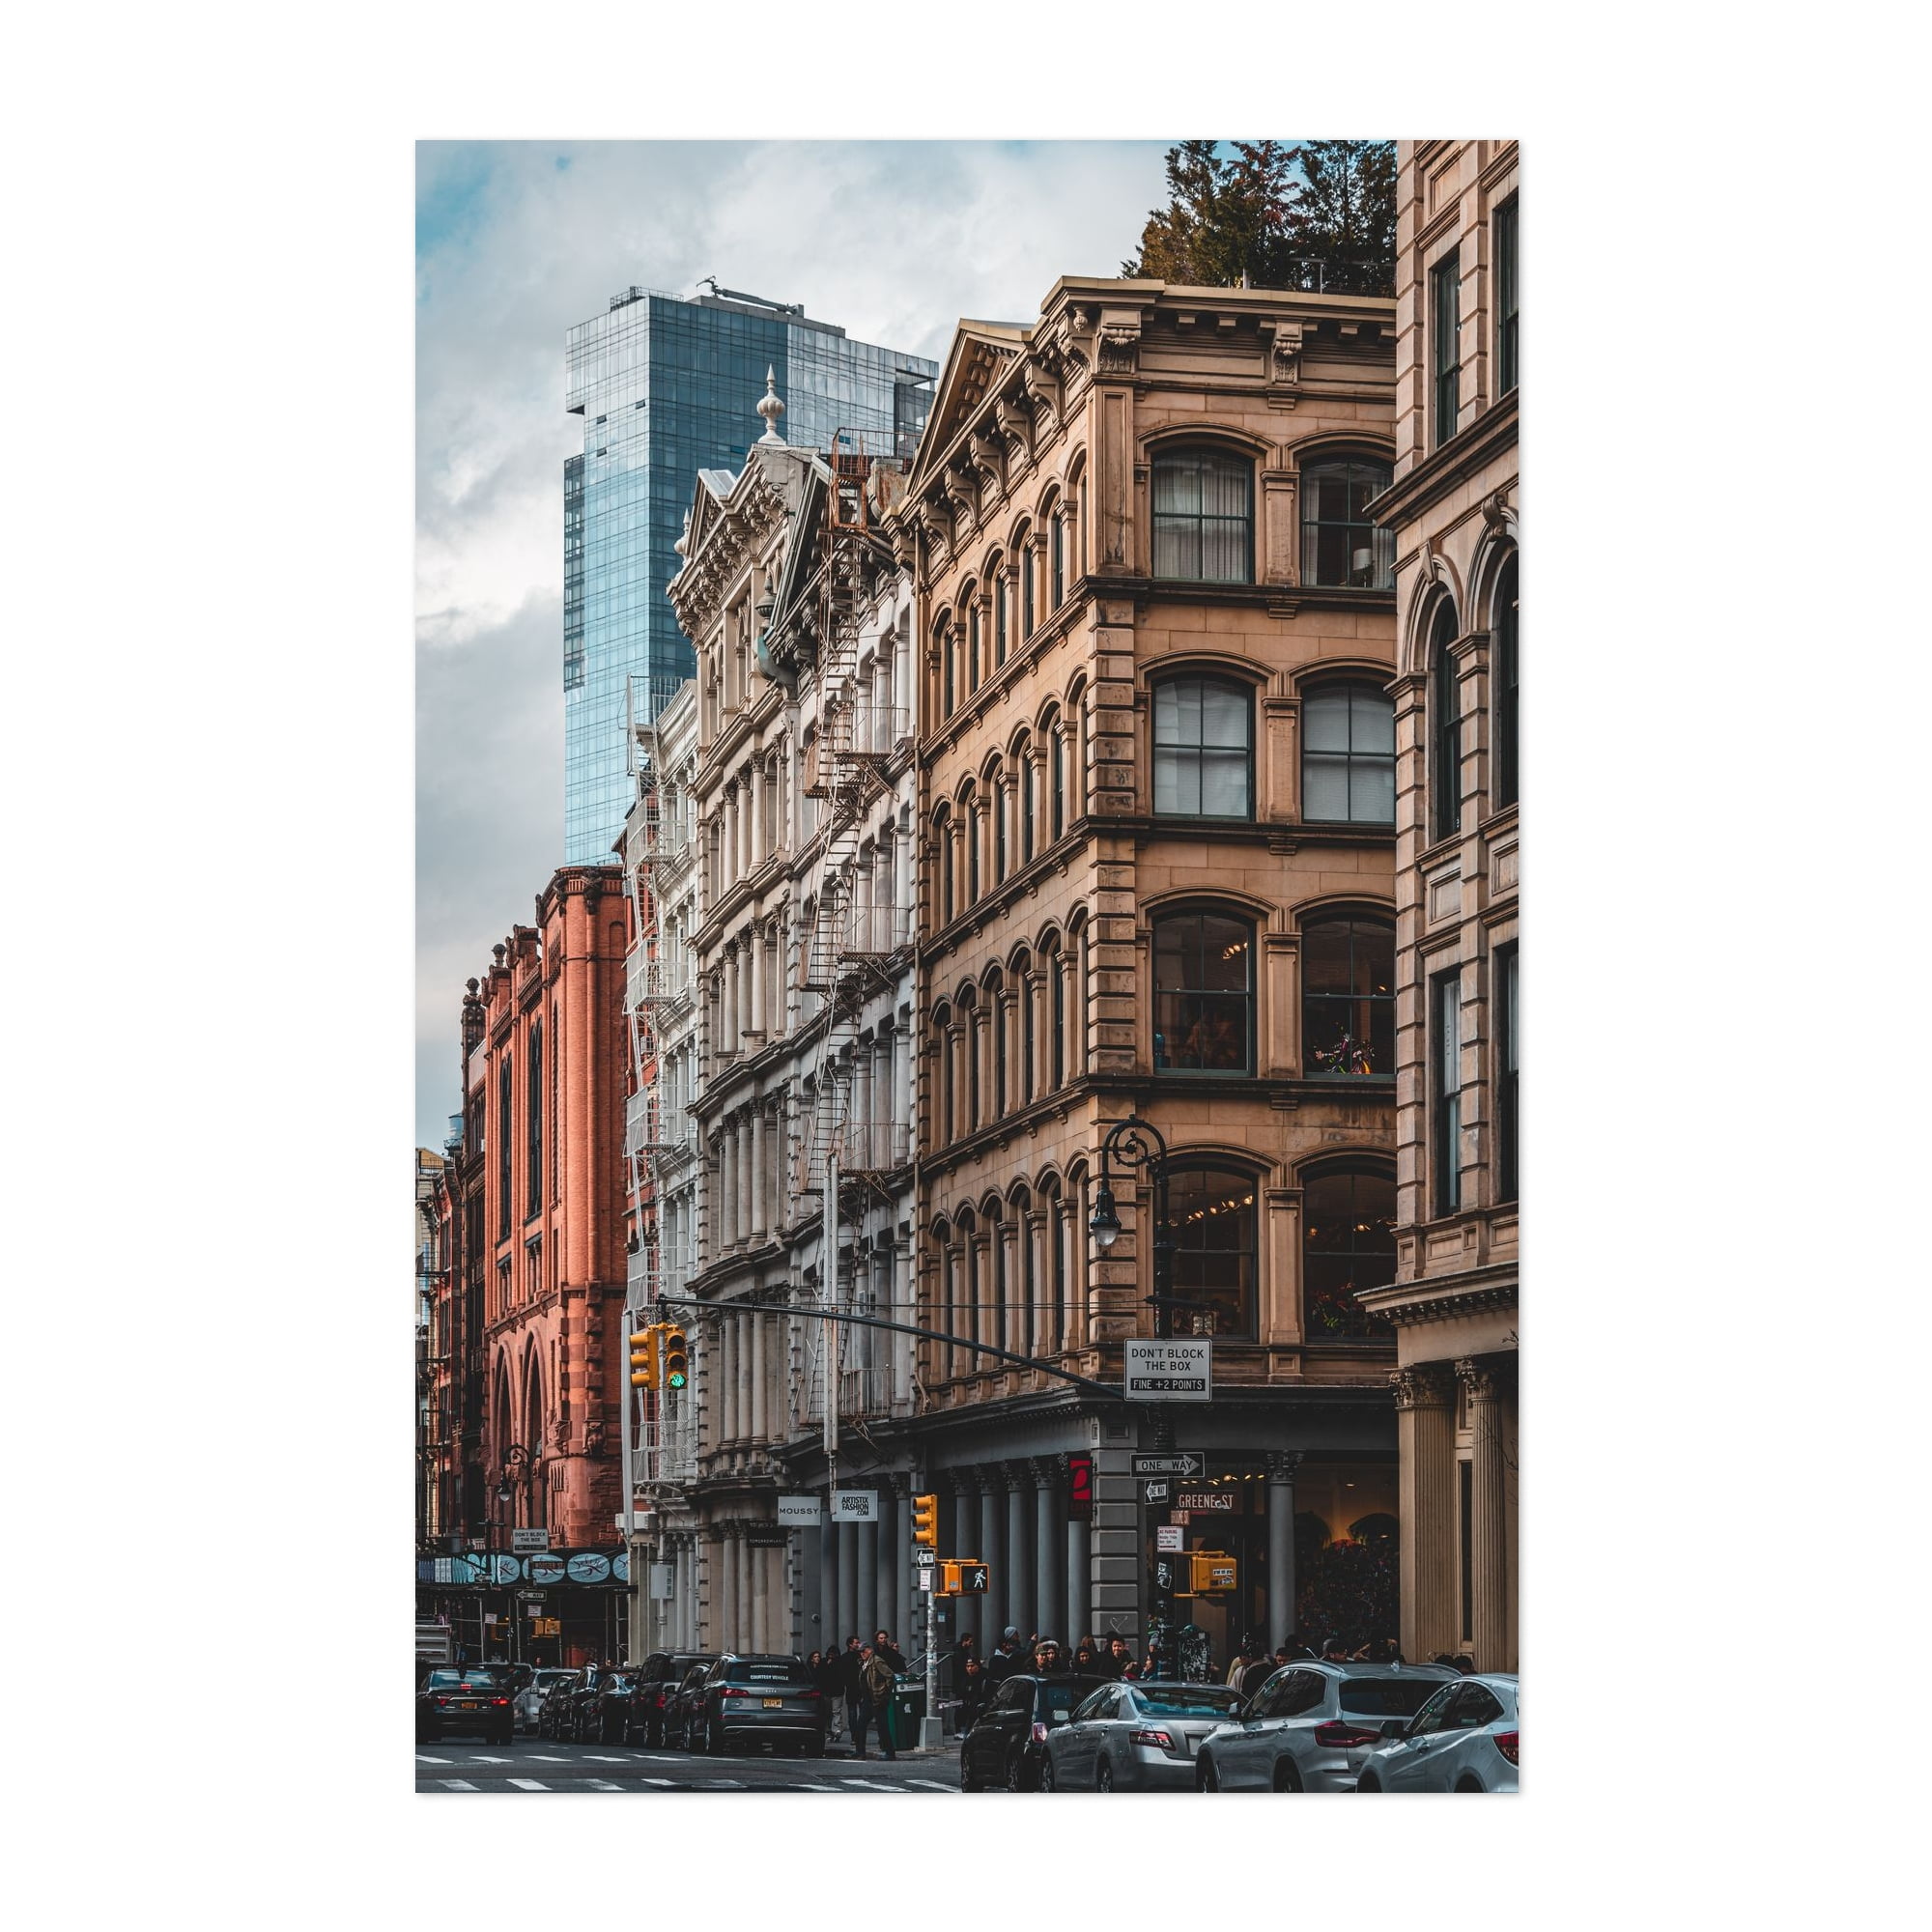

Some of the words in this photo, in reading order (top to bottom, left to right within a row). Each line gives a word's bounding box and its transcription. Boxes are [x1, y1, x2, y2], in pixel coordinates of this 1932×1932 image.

[1131, 1348, 1164, 1358] DON'T
[1167, 1349, 1205, 1359] BLOCK
[1145, 1360, 1166, 1371] THE
[1170, 1361, 1191, 1371] BOX
[1133, 1379, 1152, 1389] FINE
[1155, 1379, 1170, 1390] +2
[1172, 1379, 1203, 1390] POINTS
[1141, 1461, 1162, 1470] ONE
[1171, 1460, 1193, 1470] WAY
[1179, 1494, 1216, 1509] GREENE
[1221, 1494, 1234, 1509] ST
